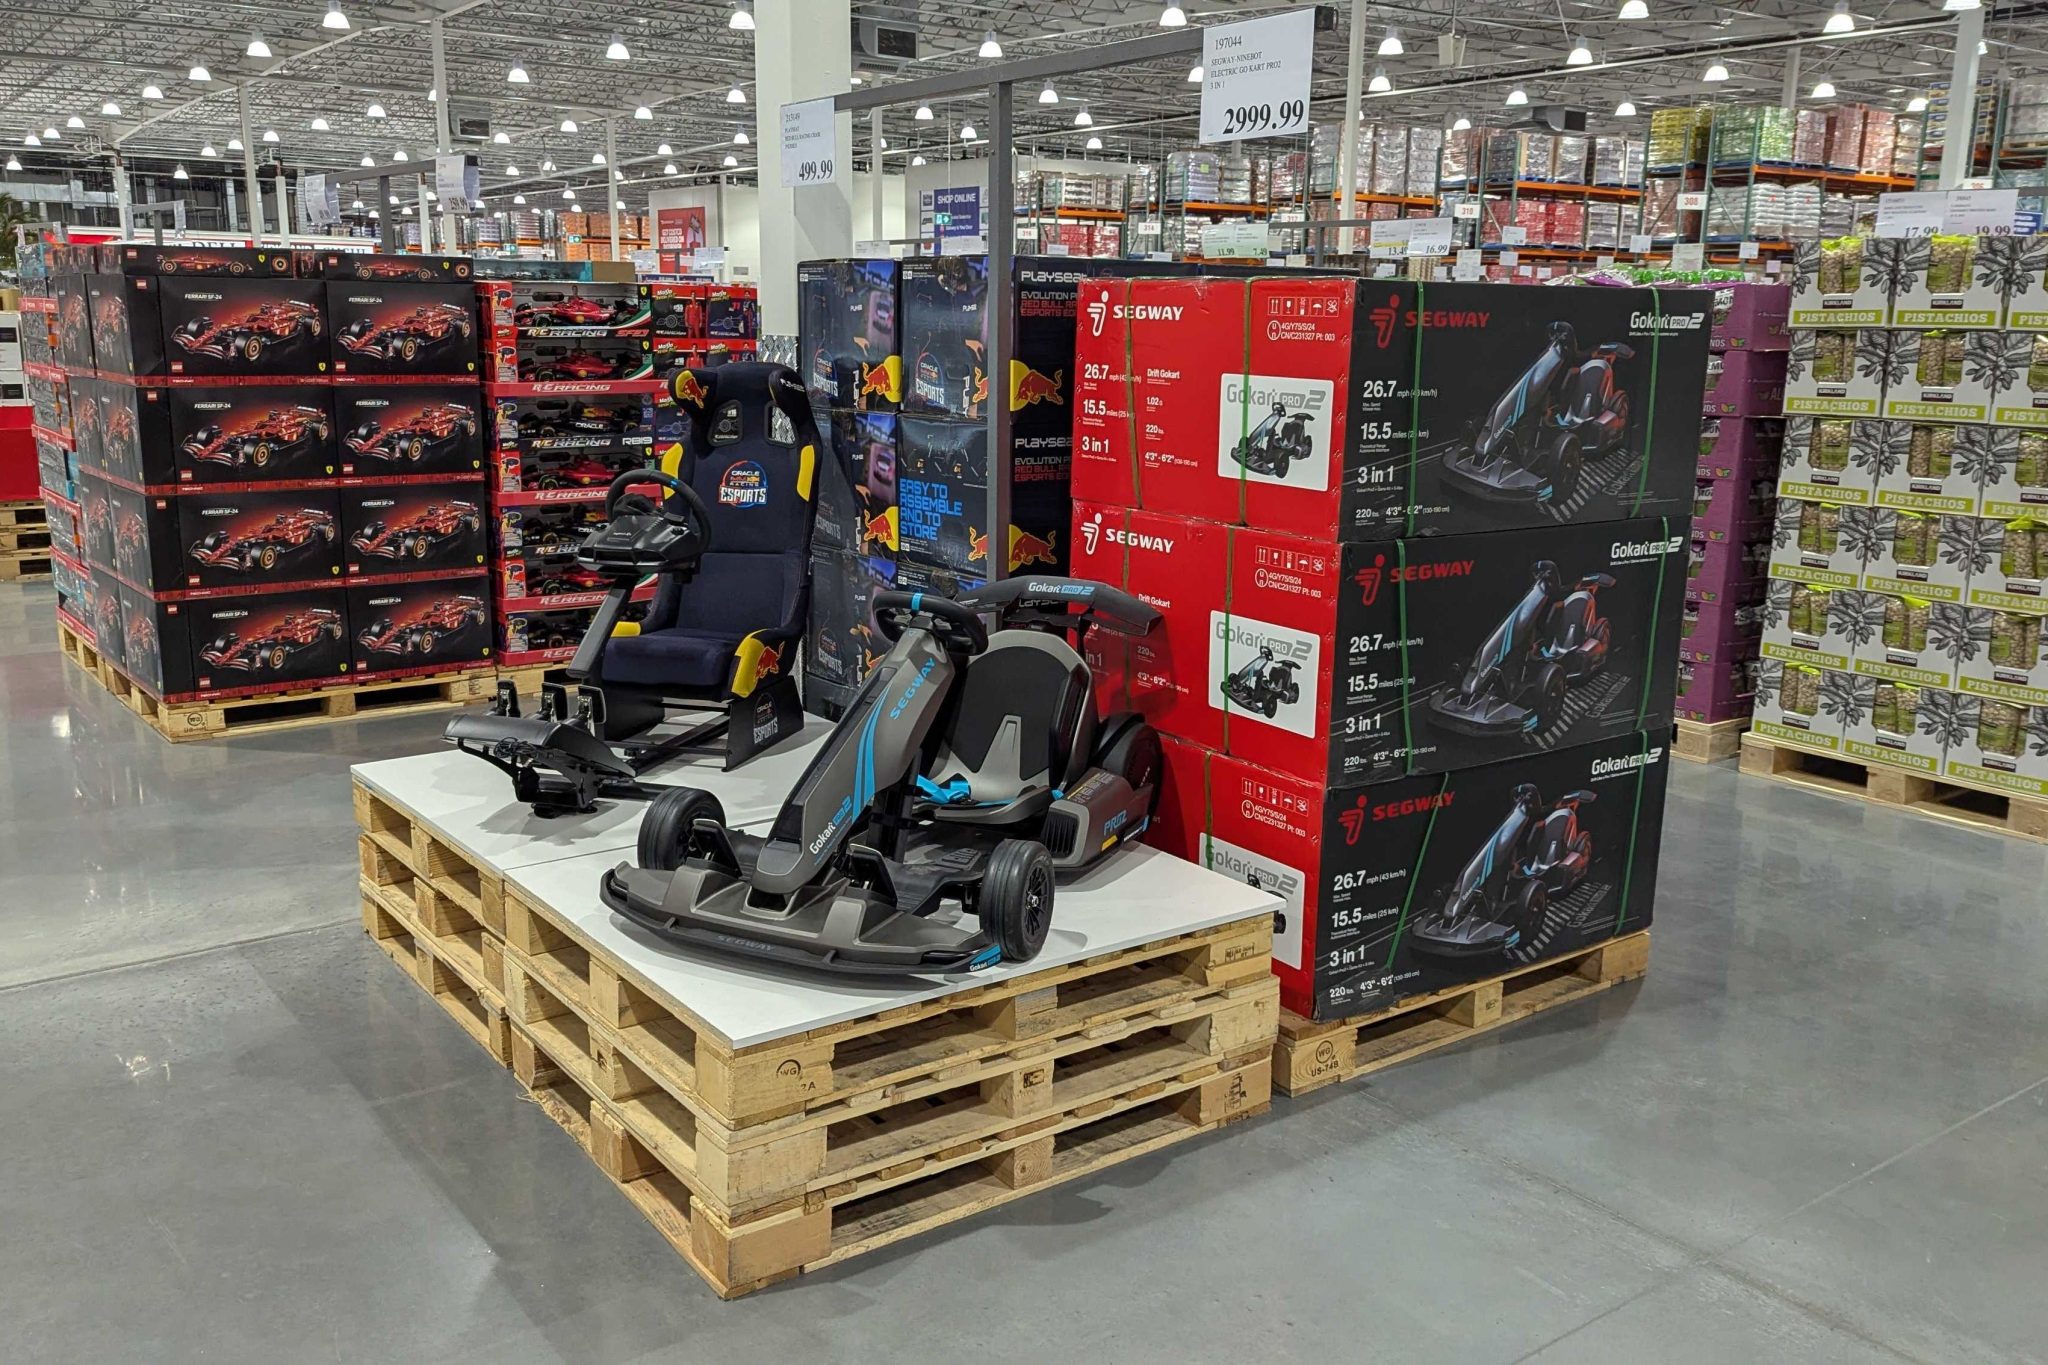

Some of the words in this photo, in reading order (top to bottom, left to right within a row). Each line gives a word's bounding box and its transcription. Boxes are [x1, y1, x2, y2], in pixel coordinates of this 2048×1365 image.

[1215, 36, 1242, 50] 197044
[1211, 52, 1262, 66] SEGWAY-NINEBOT
[1211, 66, 1239, 78] ELECTRIC
[1239, 64, 1248, 73] GO
[1249, 63, 1265, 72] KART
[1223, 99, 1304, 135] 2999.99
[799, 160, 833, 181] 499.99
[937, 195, 954, 205] SHOP
[954, 193, 976, 204] ONLINE
[1425, 245, 1448, 254] 16.99
[1021, 291, 1069, 300] EVOLUTION
[1041, 300, 1064, 308] BULL
[1020, 308, 1061, 317] ESPORTS
[1113, 304, 1184, 321] SEGWAY
[1404, 310, 1490, 328] SEGWAY
[1799, 311, 1876, 323] PISTACHIOS
[1903, 313, 1988, 323] PISTACHIOS
[1084, 363, 1110, 380] 26.7
[1147, 368, 1160, 378] Drift
[1160, 369, 1180, 379] Gokart
[554, 384, 611, 392] RACING
[916, 378, 944, 405] ESPORTS
[1362, 380, 1397, 398] 26.7
[1397, 389, 1410, 399] mph
[1083, 399, 1106, 416] 15.5
[1792, 400, 1869, 412] PISTACHIOS
[1895, 404, 1978, 417] PISTACHIOS
[1145, 424, 1158, 433] 220
[1360, 422, 1392, 440] 15.5
[553, 438, 611, 447] RACING
[1082, 436, 1090, 451] 3
[1091, 437, 1102, 452] in
[1104, 438, 1109, 453] 1
[1014, 456, 1062, 465] EVOLUTION
[1357, 466, 1368, 484] 3
[1371, 466, 1384, 483] in
[1387, 465, 1394, 482] 1
[720, 487, 767, 503] ESPORTS
[900, 478, 930, 496] EASY
[932, 483, 948, 499] TO
[1787, 484, 1862, 501] PISTACHIOS
[900, 493, 963, 517] ASSEMBLE
[1884, 493, 1966, 510] PISTACHIOS
[900, 507, 923, 524] AND
[925, 511, 941, 527] TO
[1355, 508, 1372, 518] 220
[900, 521, 938, 541] STORE
[1105, 528, 1174, 554] SEGWAY
[1610, 541, 1649, 559] Gokart
[1390, 560, 1474, 583] SEGWAY
[1777, 566, 1851, 584] PISTACHIOS
[1028, 582, 1061, 594] Gokart
[1872, 579, 1953, 598] PISTACHIOS
[1138, 593, 1150, 604] Drift
[1150, 596, 1171, 609] Gokart
[1349, 633, 1383, 654] 26.7
[1769, 646, 1841, 667] PISTACHIOS
[1861, 663, 1942, 684] PISTACHIOS
[889, 656, 936, 721] SEGWAY
[1347, 673, 1378, 693] 15.5
[753, 716, 778, 744] ESPORTS
[1345, 717, 1356, 734] 3
[1358, 716, 1371, 732] in
[1374, 713, 1381, 729] 1
[1760, 723, 1832, 746] PISTACHIOS
[1344, 756, 1360, 767] 220
[1852, 743, 1930, 768] PISTACHIOS
[1591, 755, 1630, 775] Gokart
[1372, 791, 1455, 821] SEGWAY
[809, 822, 837, 855] Gokart
[1333, 869, 1367, 891] 26.7
[1366, 875, 1379, 885] mph
[1331, 907, 1362, 928] 15.5
[1329, 951, 1340, 967] 3
[1342, 949, 1355, 964] in
[1358, 944, 1365, 960] 1
[1329, 986, 1346, 998] 220
